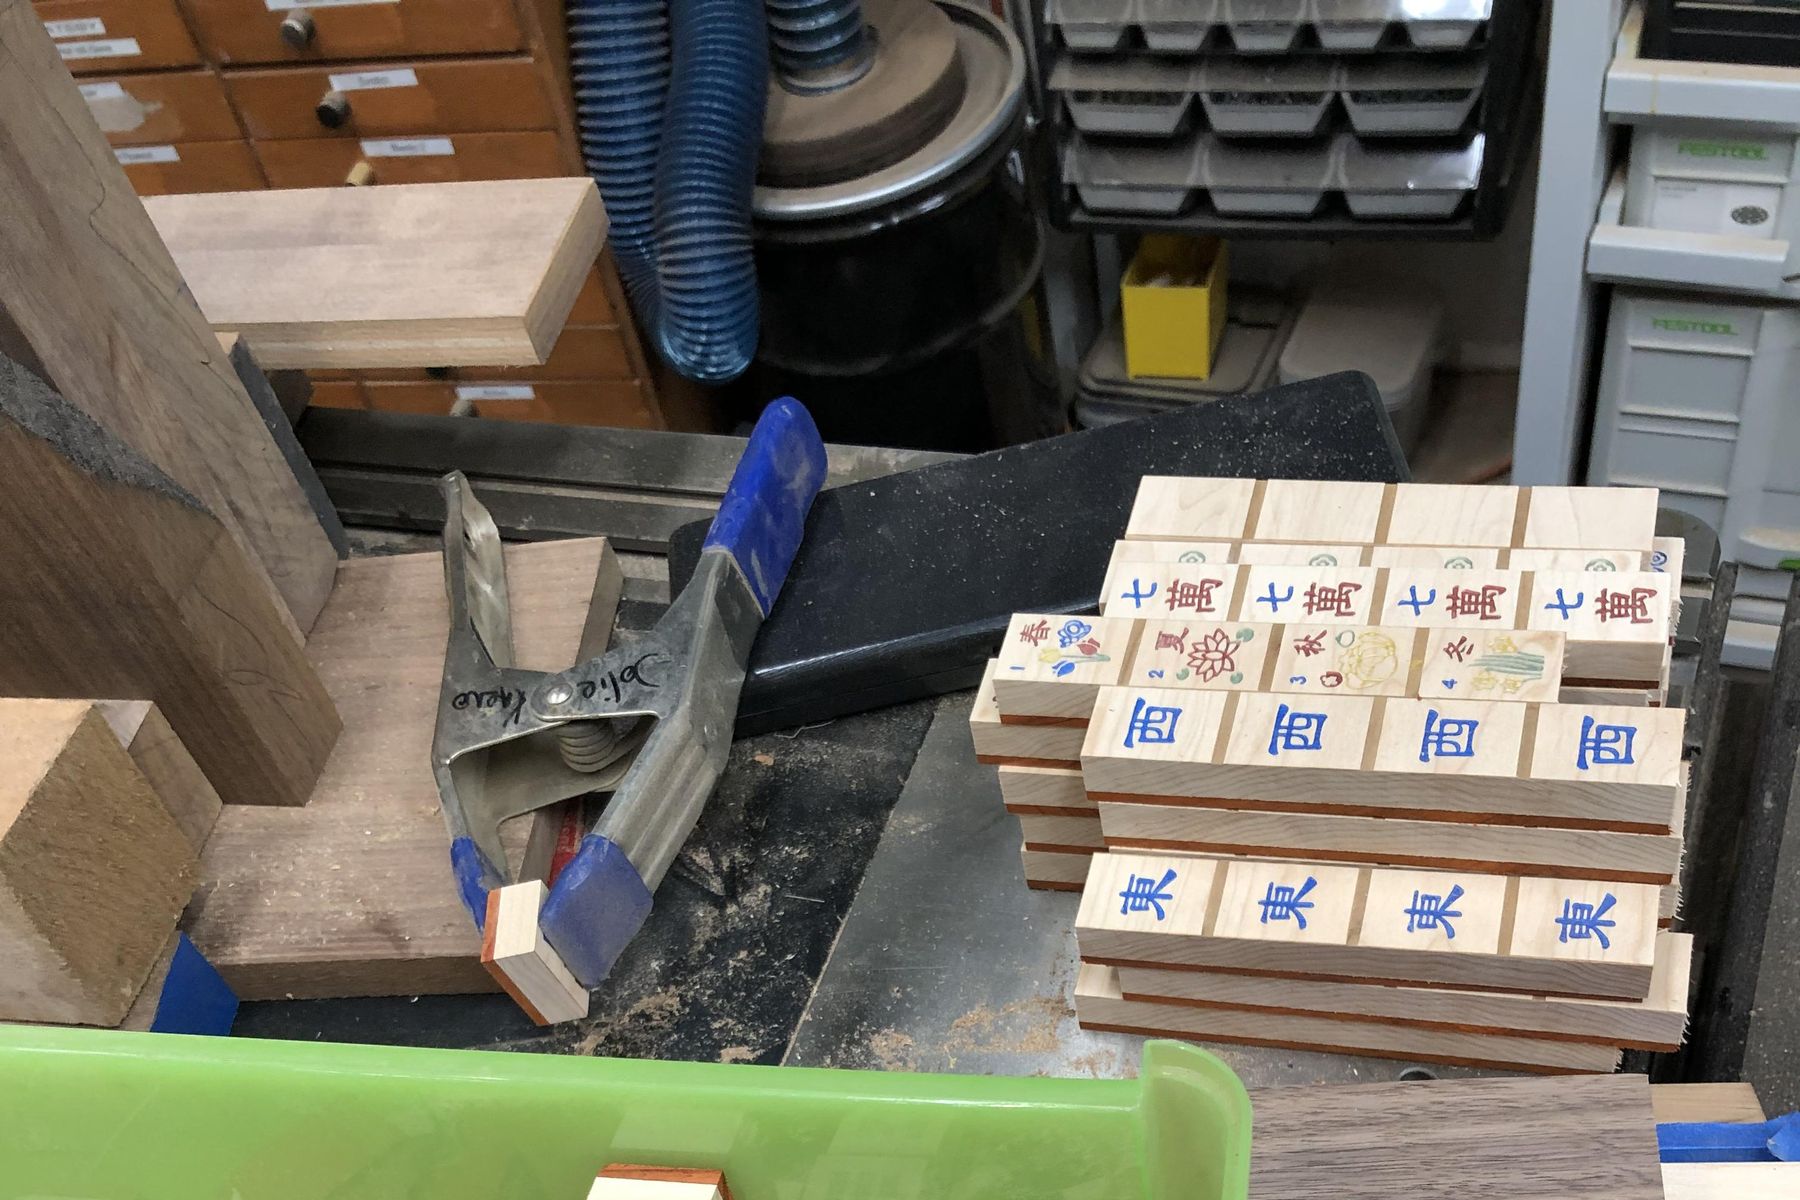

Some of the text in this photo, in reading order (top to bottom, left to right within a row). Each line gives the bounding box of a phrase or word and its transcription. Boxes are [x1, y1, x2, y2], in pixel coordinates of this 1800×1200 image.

[1020, 619, 1052, 647] 春
[1155, 627, 1190, 655] 夏
[1293, 629, 1328, 657] 秋
[1443, 635, 1475, 663] 冬
[1123, 697, 1183, 749] 西
[1268, 703, 1328, 756] 西
[1419, 709, 1479, 762] 西
[1576, 715, 1637, 770] 西
[1119, 868, 1178, 921] 東
[1258, 876, 1318, 930] 東
[1403, 884, 1465, 940] 東
[1554, 892, 1617, 949] 東
